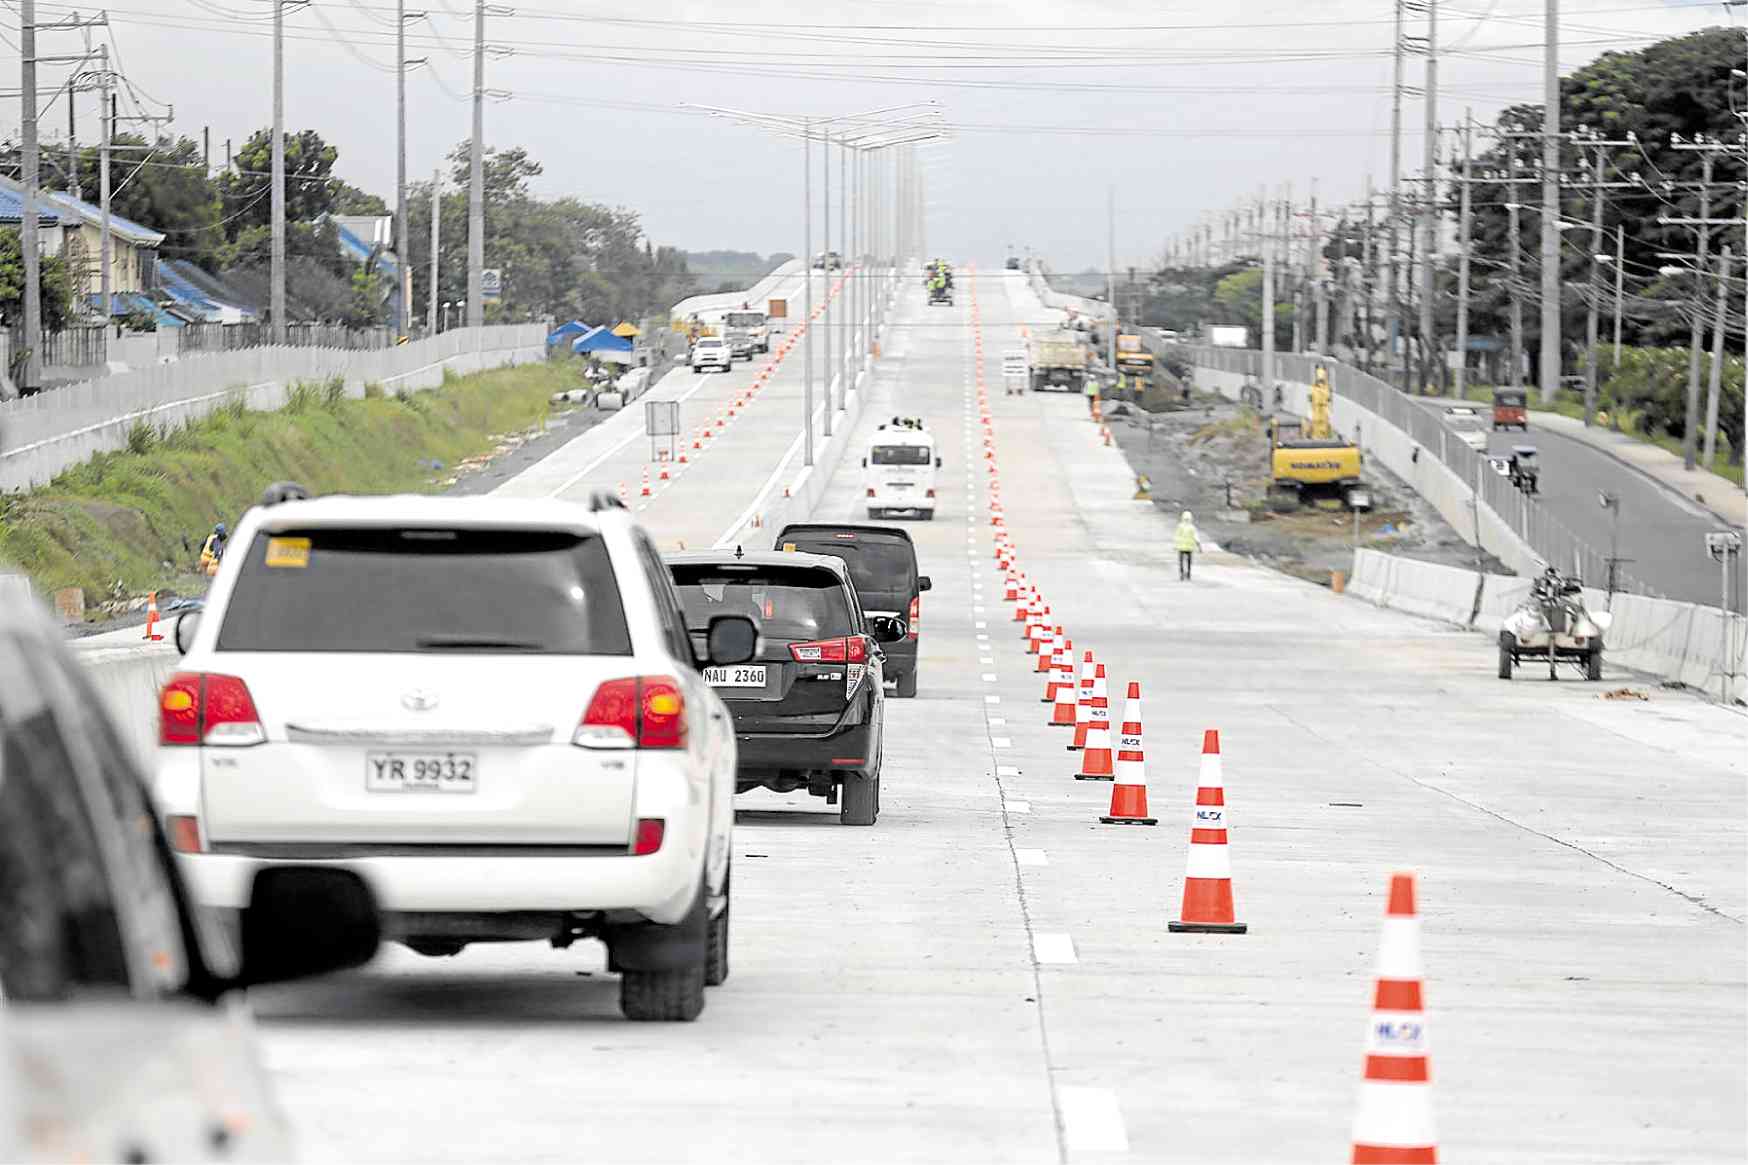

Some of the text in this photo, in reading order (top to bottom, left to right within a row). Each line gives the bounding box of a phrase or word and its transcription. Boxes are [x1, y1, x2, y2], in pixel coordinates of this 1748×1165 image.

[703, 670, 765, 683] NAU 2360
[373, 759, 471, 781] YR 9932
